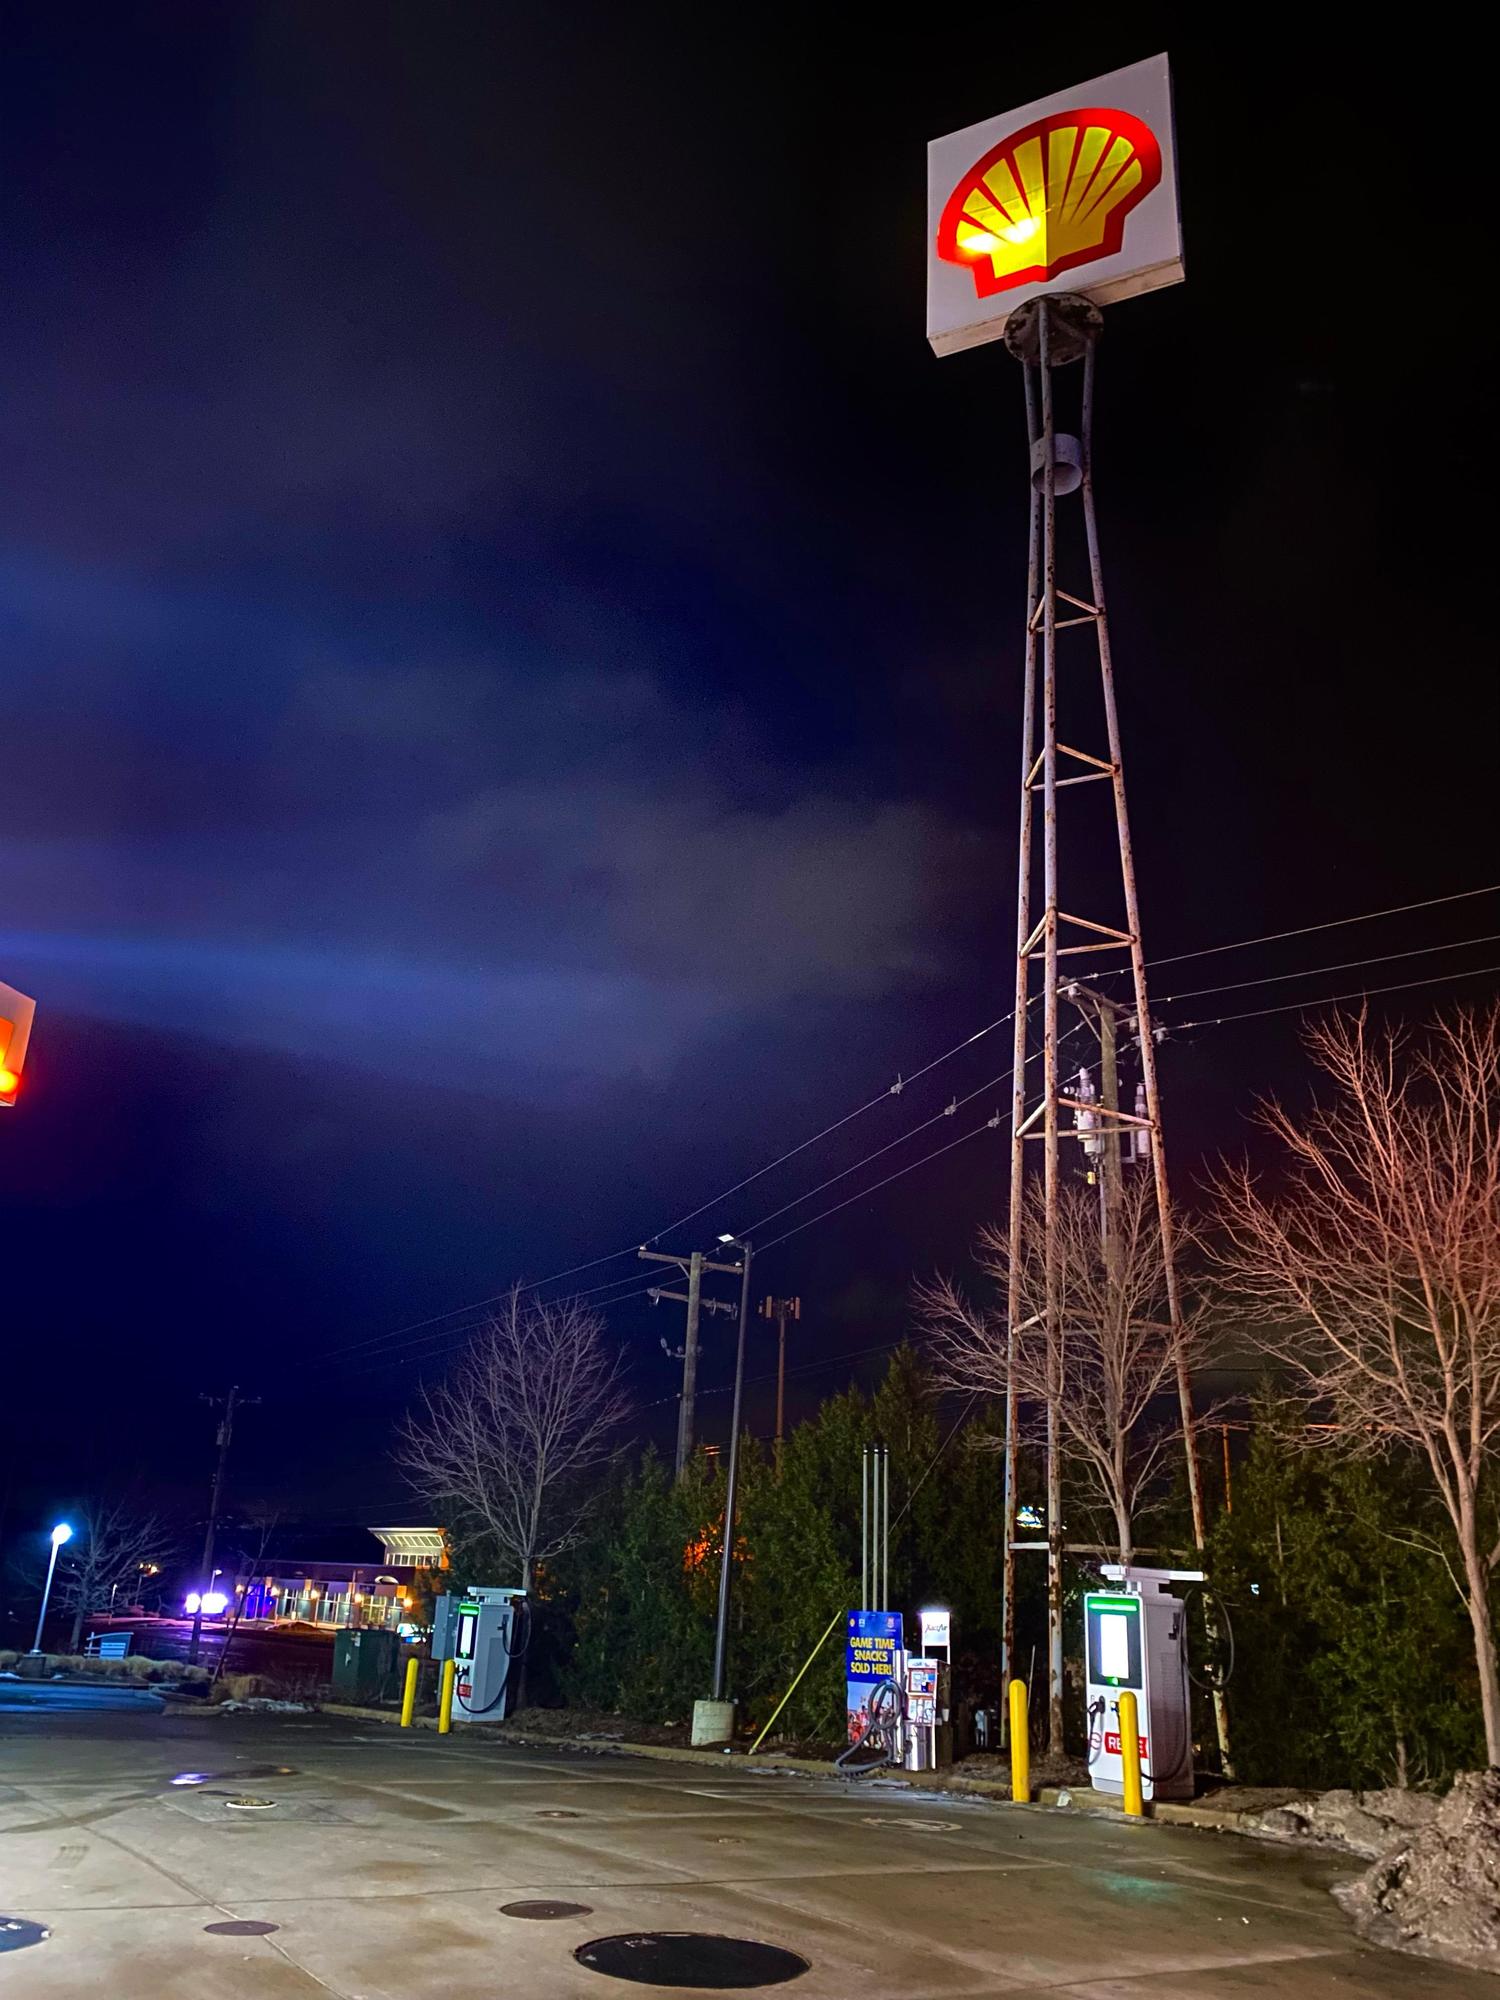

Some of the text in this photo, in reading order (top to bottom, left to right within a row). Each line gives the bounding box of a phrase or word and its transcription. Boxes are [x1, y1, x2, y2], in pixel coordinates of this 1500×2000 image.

[850, 1637, 895, 1649] GAME TIME
[854, 1649, 888, 1662] SNACKS
[851, 1661, 870, 1673] SOLD
